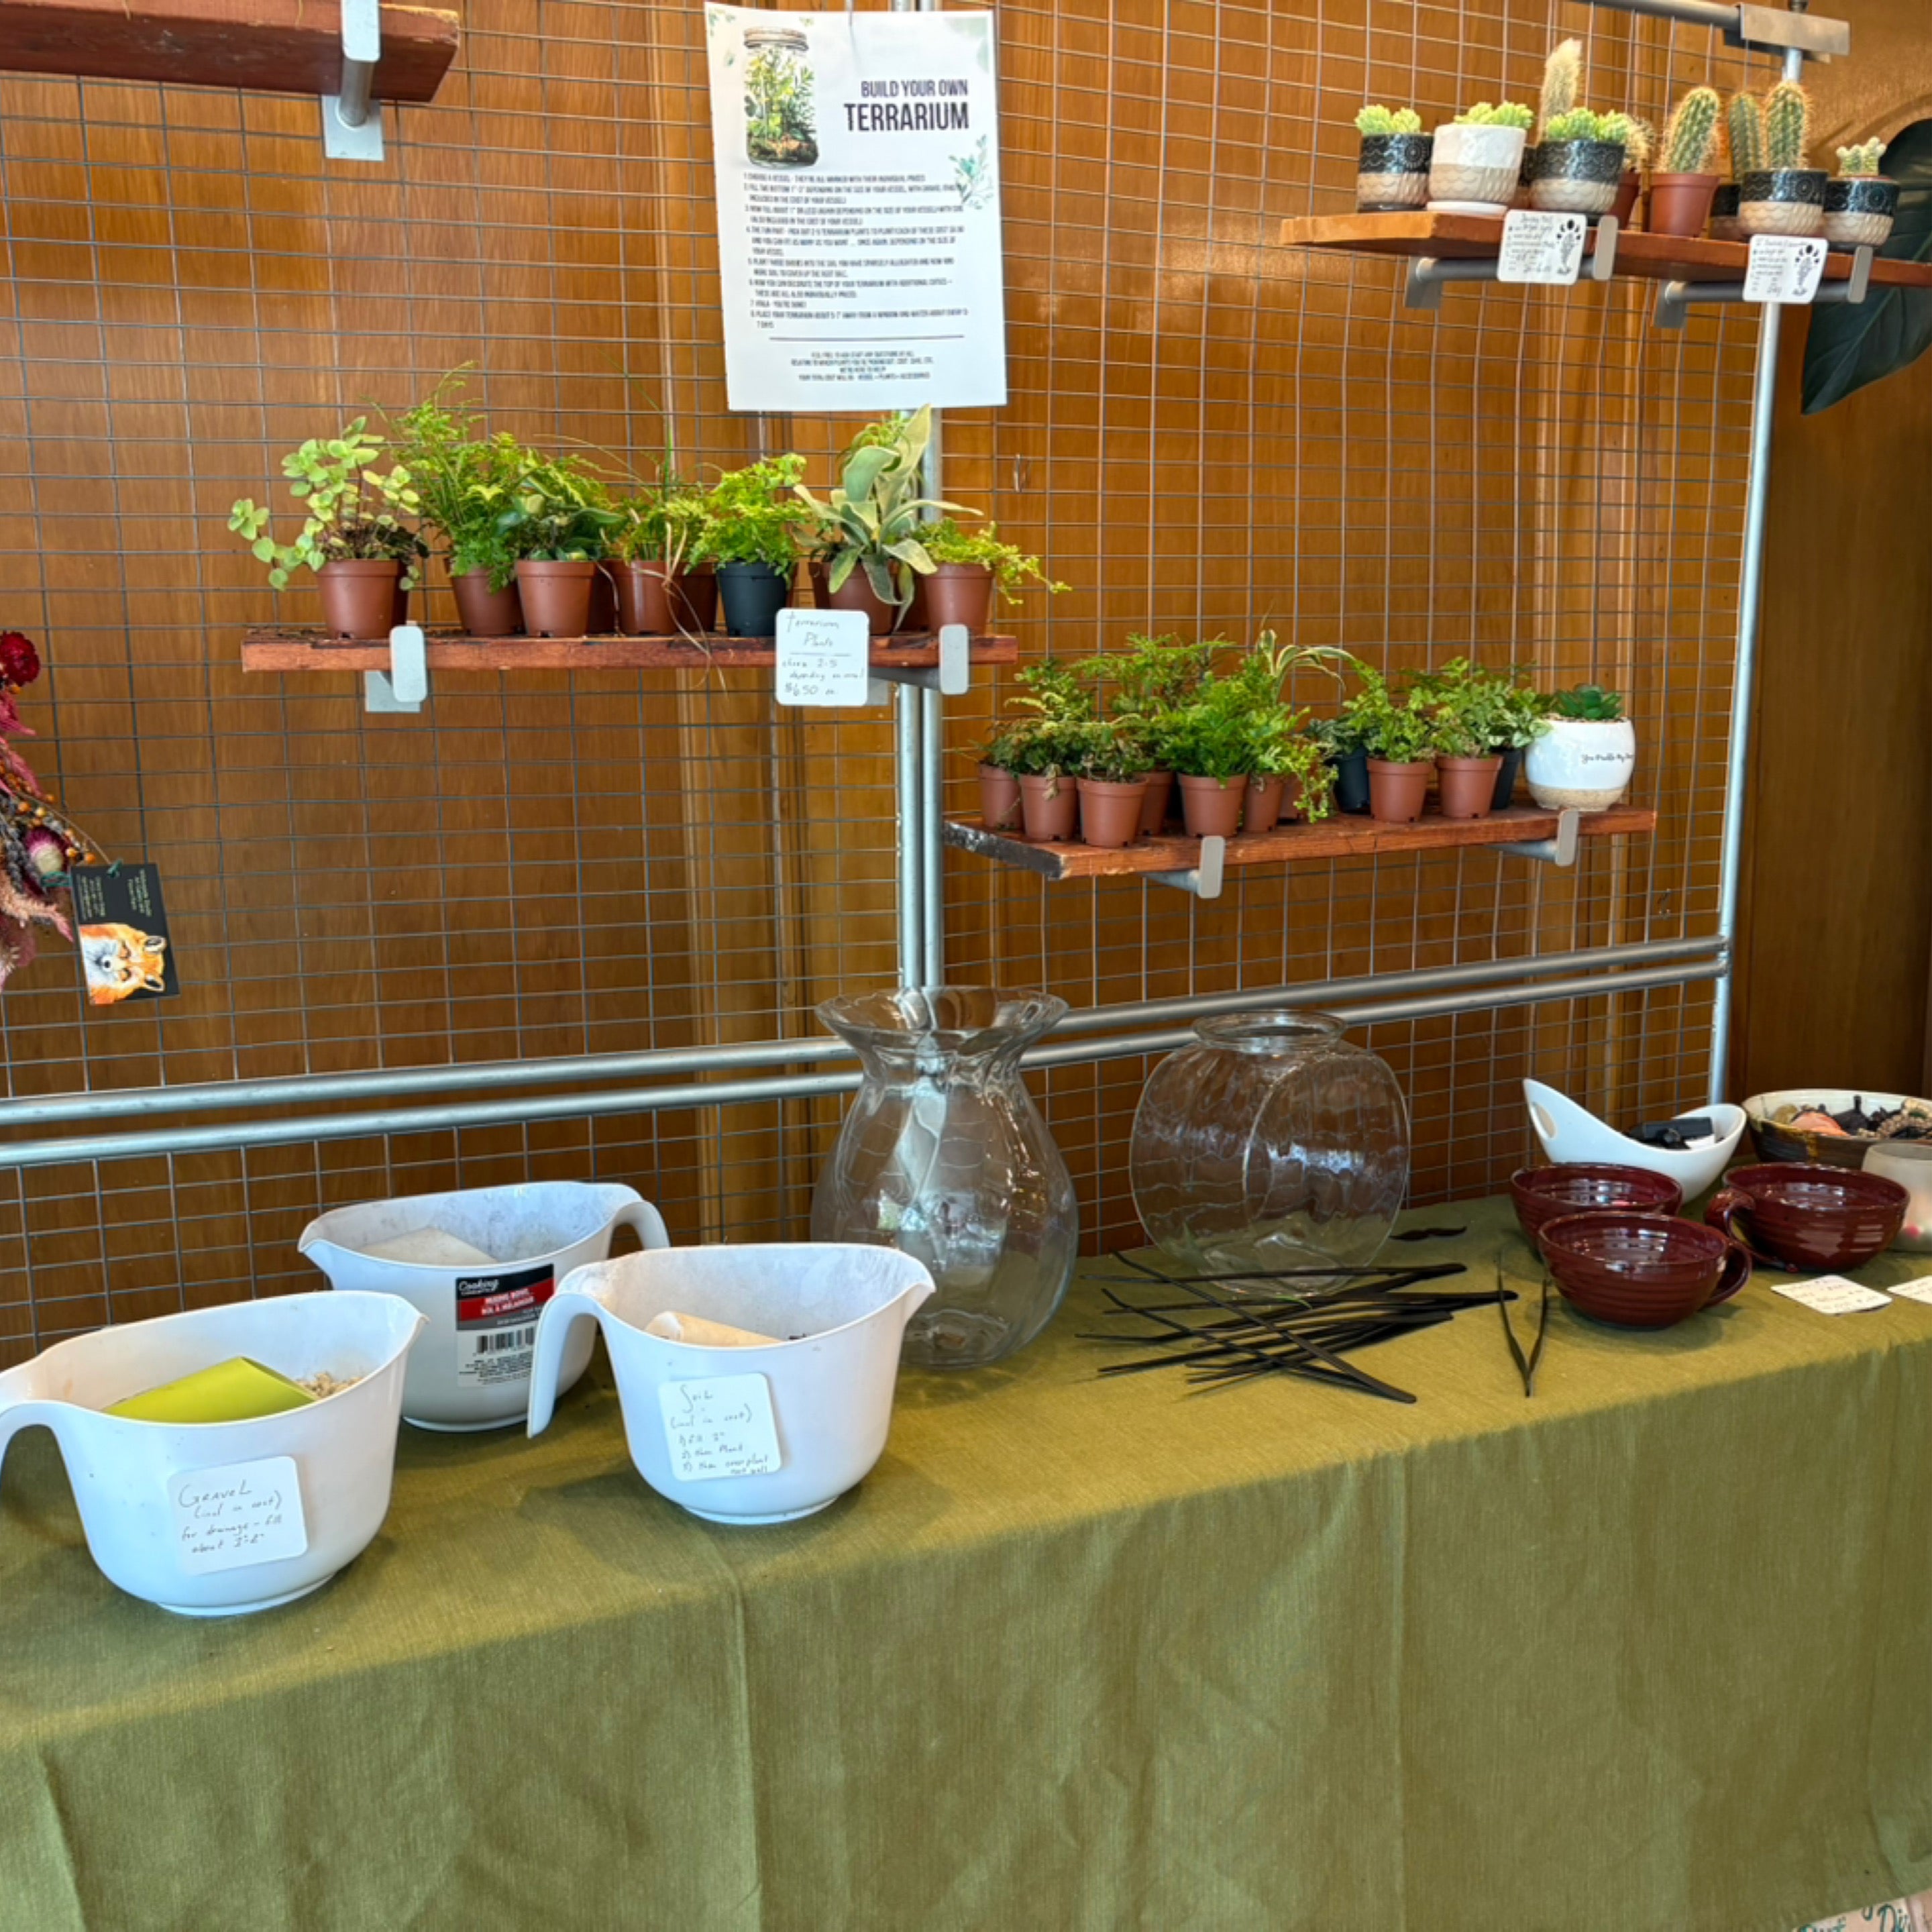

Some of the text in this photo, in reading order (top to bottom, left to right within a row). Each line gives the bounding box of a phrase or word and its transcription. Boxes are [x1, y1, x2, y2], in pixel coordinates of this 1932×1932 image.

[861, 78, 968, 99] BUILD YOUR OWN
[844, 102, 969, 131] TERRARIUM
[459, 1279, 499, 1293] Cooking
